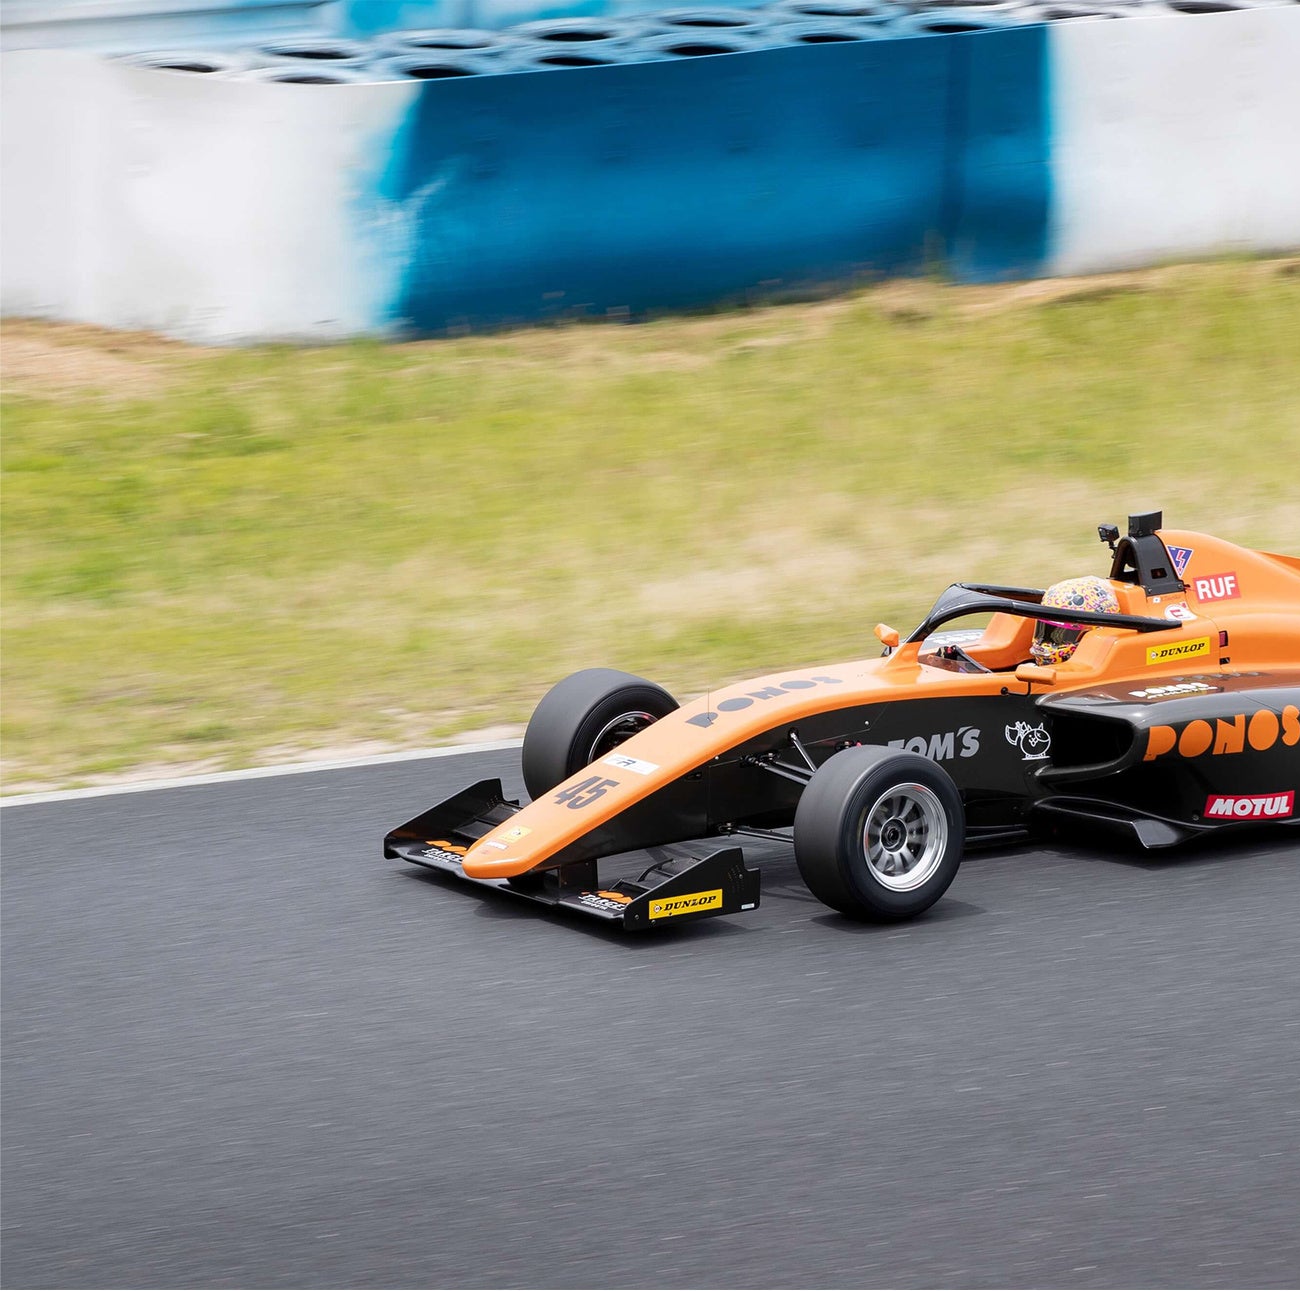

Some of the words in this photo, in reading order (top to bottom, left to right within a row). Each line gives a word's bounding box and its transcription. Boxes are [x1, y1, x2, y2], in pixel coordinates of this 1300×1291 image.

[1195, 576, 1237, 600] RUF
[1159, 642, 1206, 658] DUNLOP
[685, 676, 844, 728] PONOS
[553, 776, 620, 810] 45
[1208, 796, 1290, 816] MOTUL
[663, 895, 717, 912] DUNLOP
